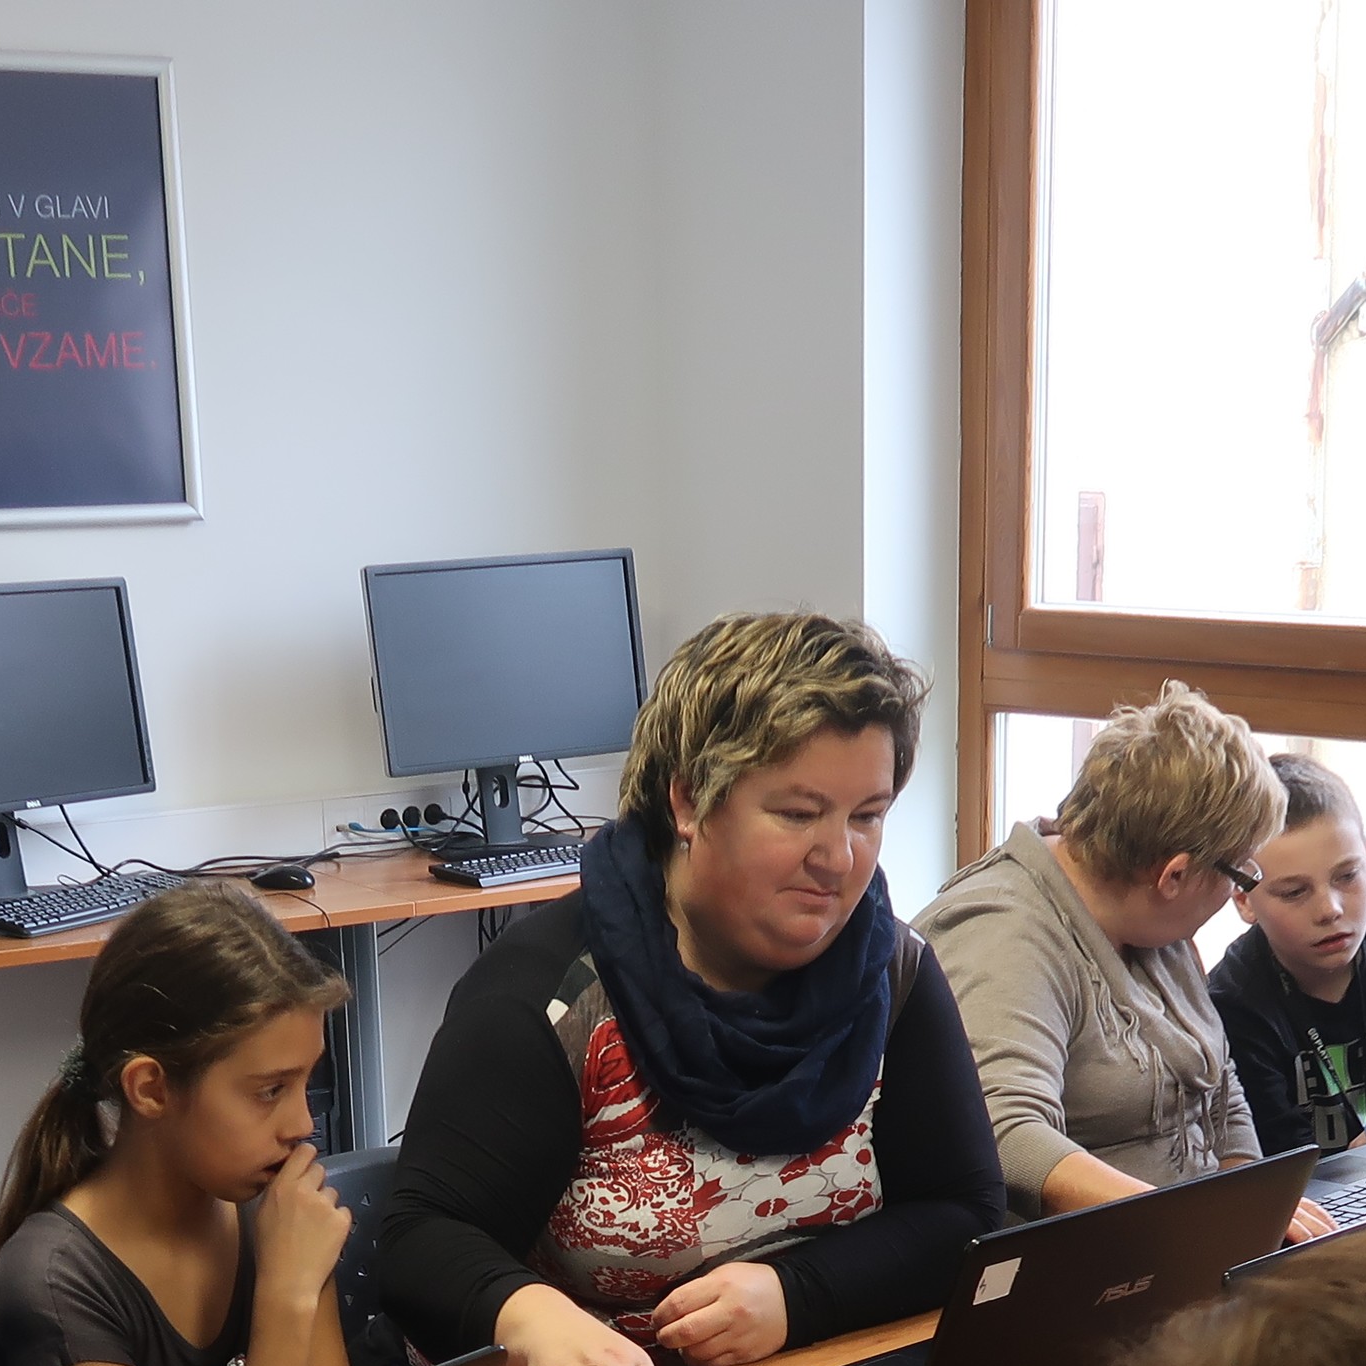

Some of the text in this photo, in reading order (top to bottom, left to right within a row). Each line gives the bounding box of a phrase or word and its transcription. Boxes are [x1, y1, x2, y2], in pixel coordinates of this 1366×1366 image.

[8, 194, 25, 219] V
[35, 194, 109, 219] GLAVI
[0, 330, 157, 371] VZAME.
[1094, 1274, 1155, 1306] ASUS
